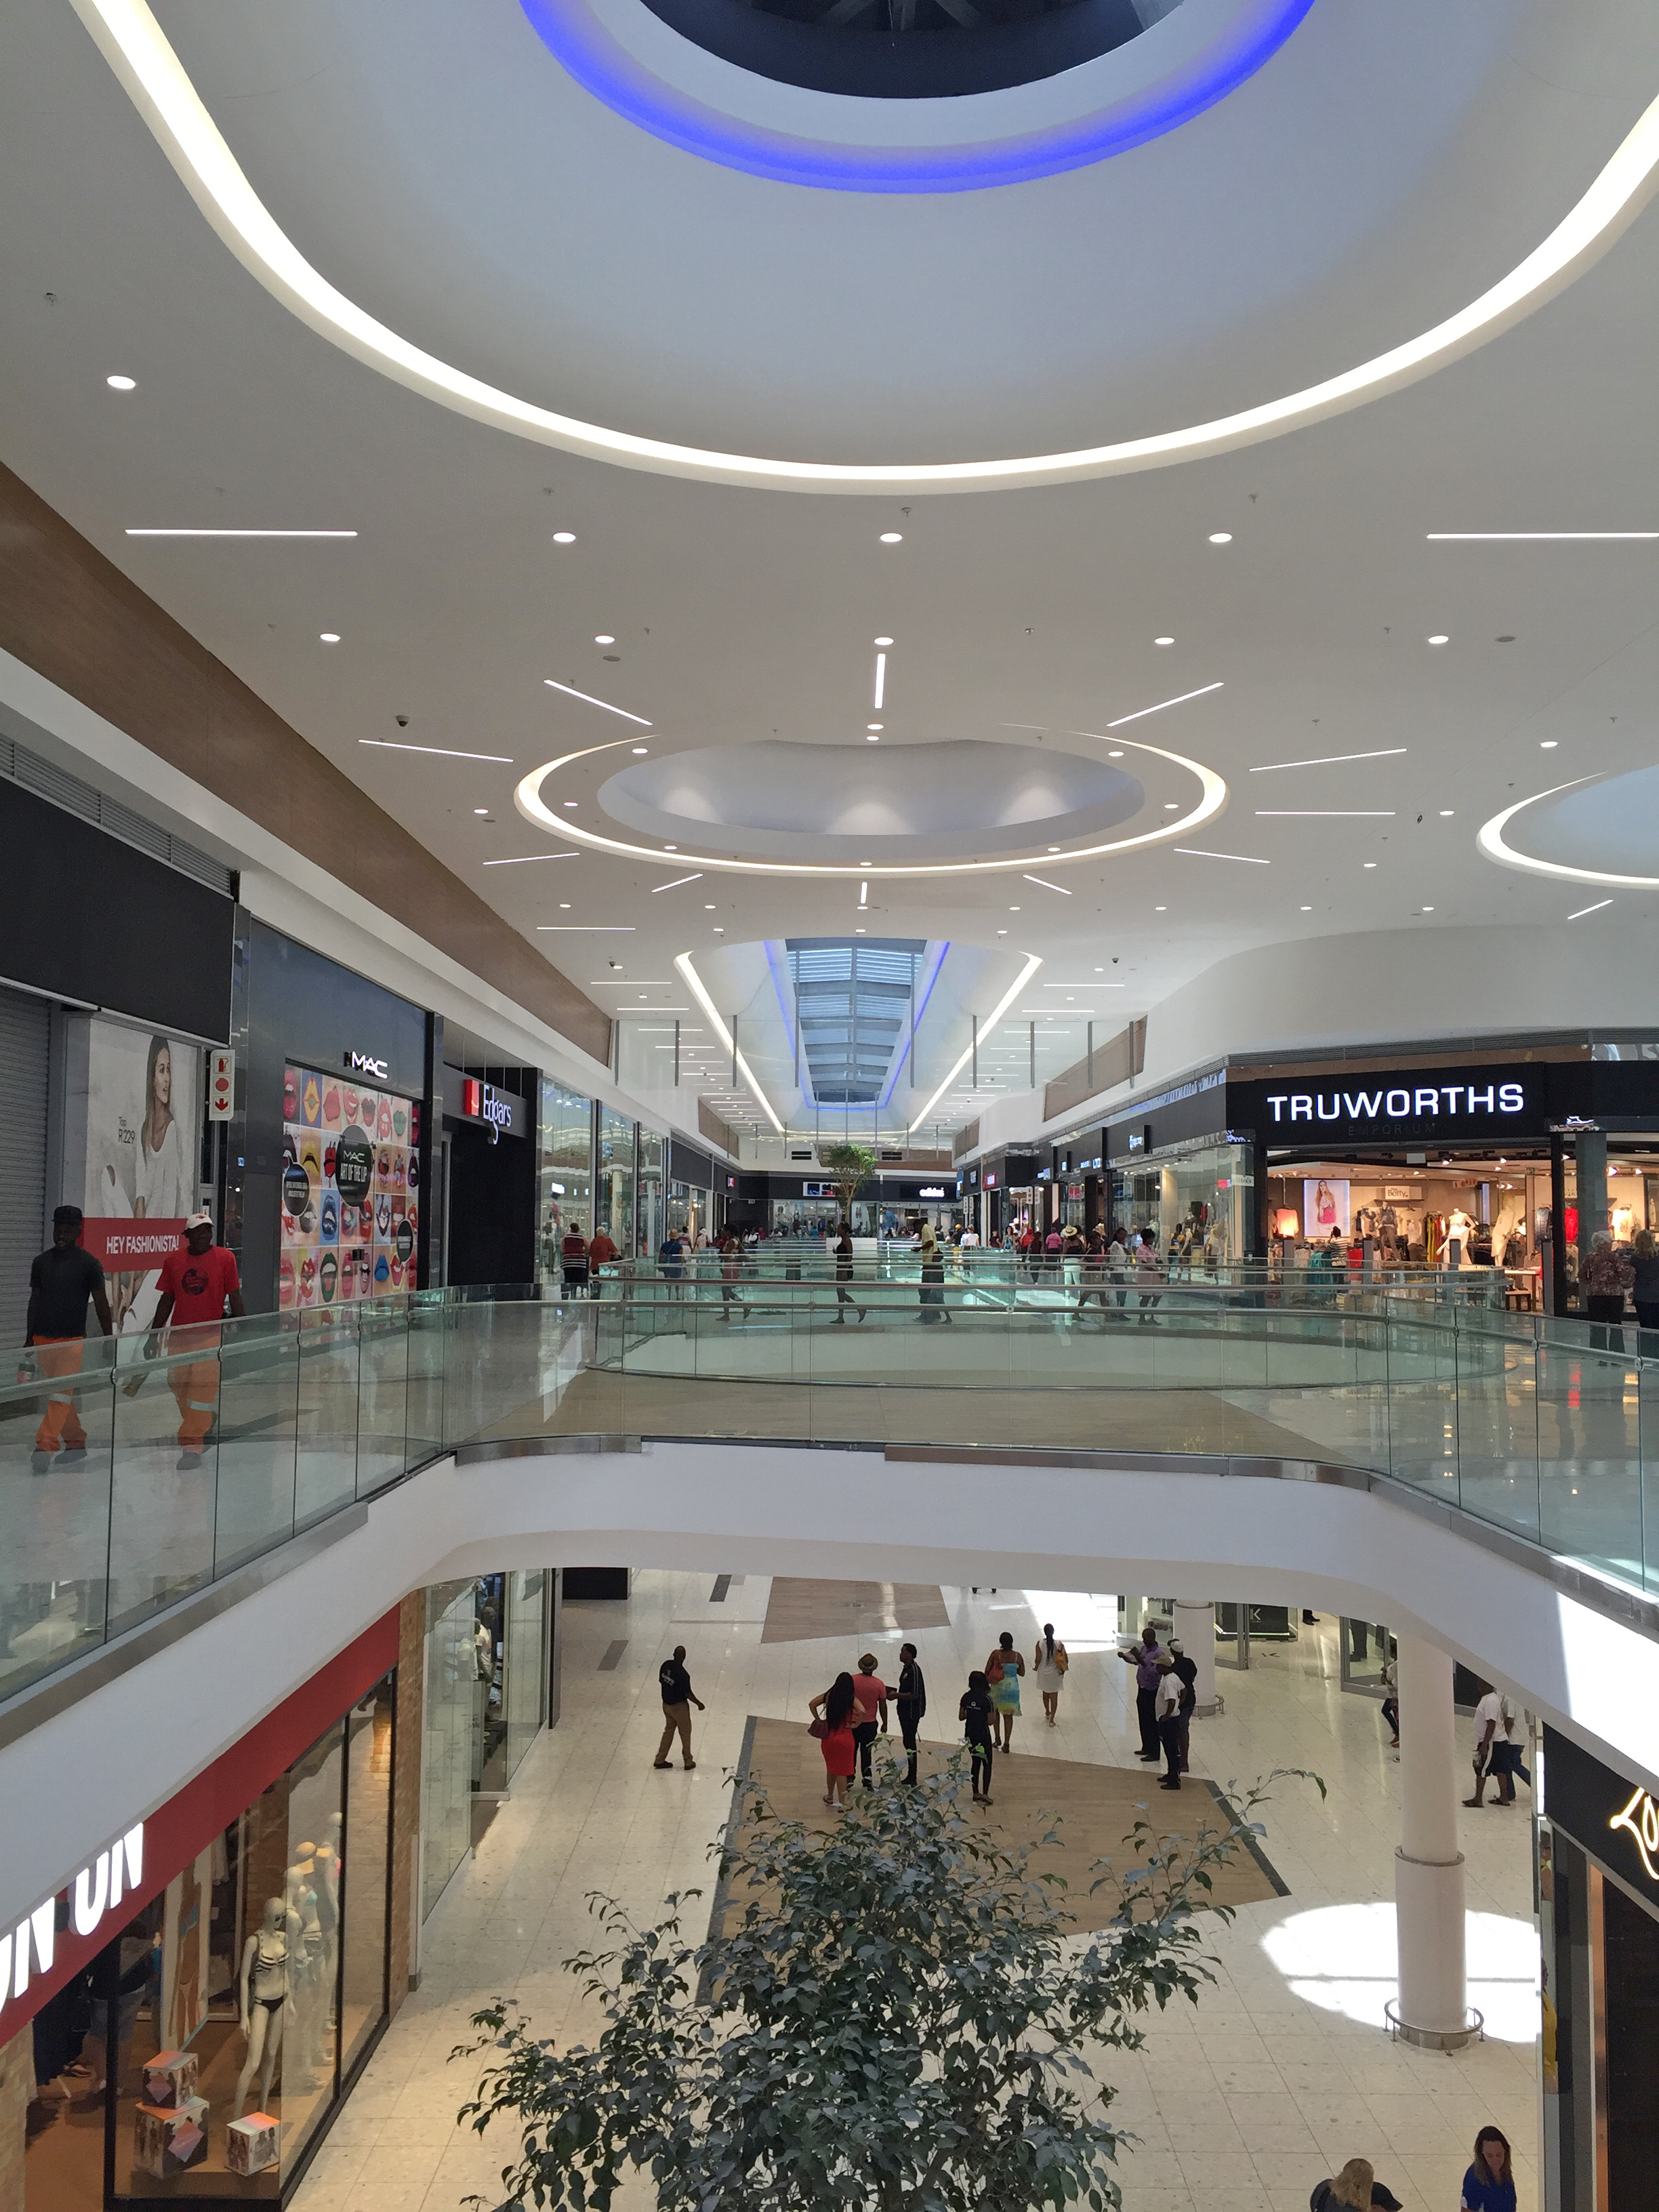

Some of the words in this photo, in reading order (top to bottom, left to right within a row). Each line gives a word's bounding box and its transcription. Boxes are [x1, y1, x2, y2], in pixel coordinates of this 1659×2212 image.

[352, 1051, 388, 1079] MAC
[483, 1084, 512, 1145] Edgars
[1267, 1084, 1525, 1122] TRUWORTHS
[1347, 1122, 1436, 1136] EMPORIUM
[343, 1150, 365, 1163] MAC
[106, 1235, 125, 1254] HEY
[125, 1234, 180, 1254] FASHIONISTA!
